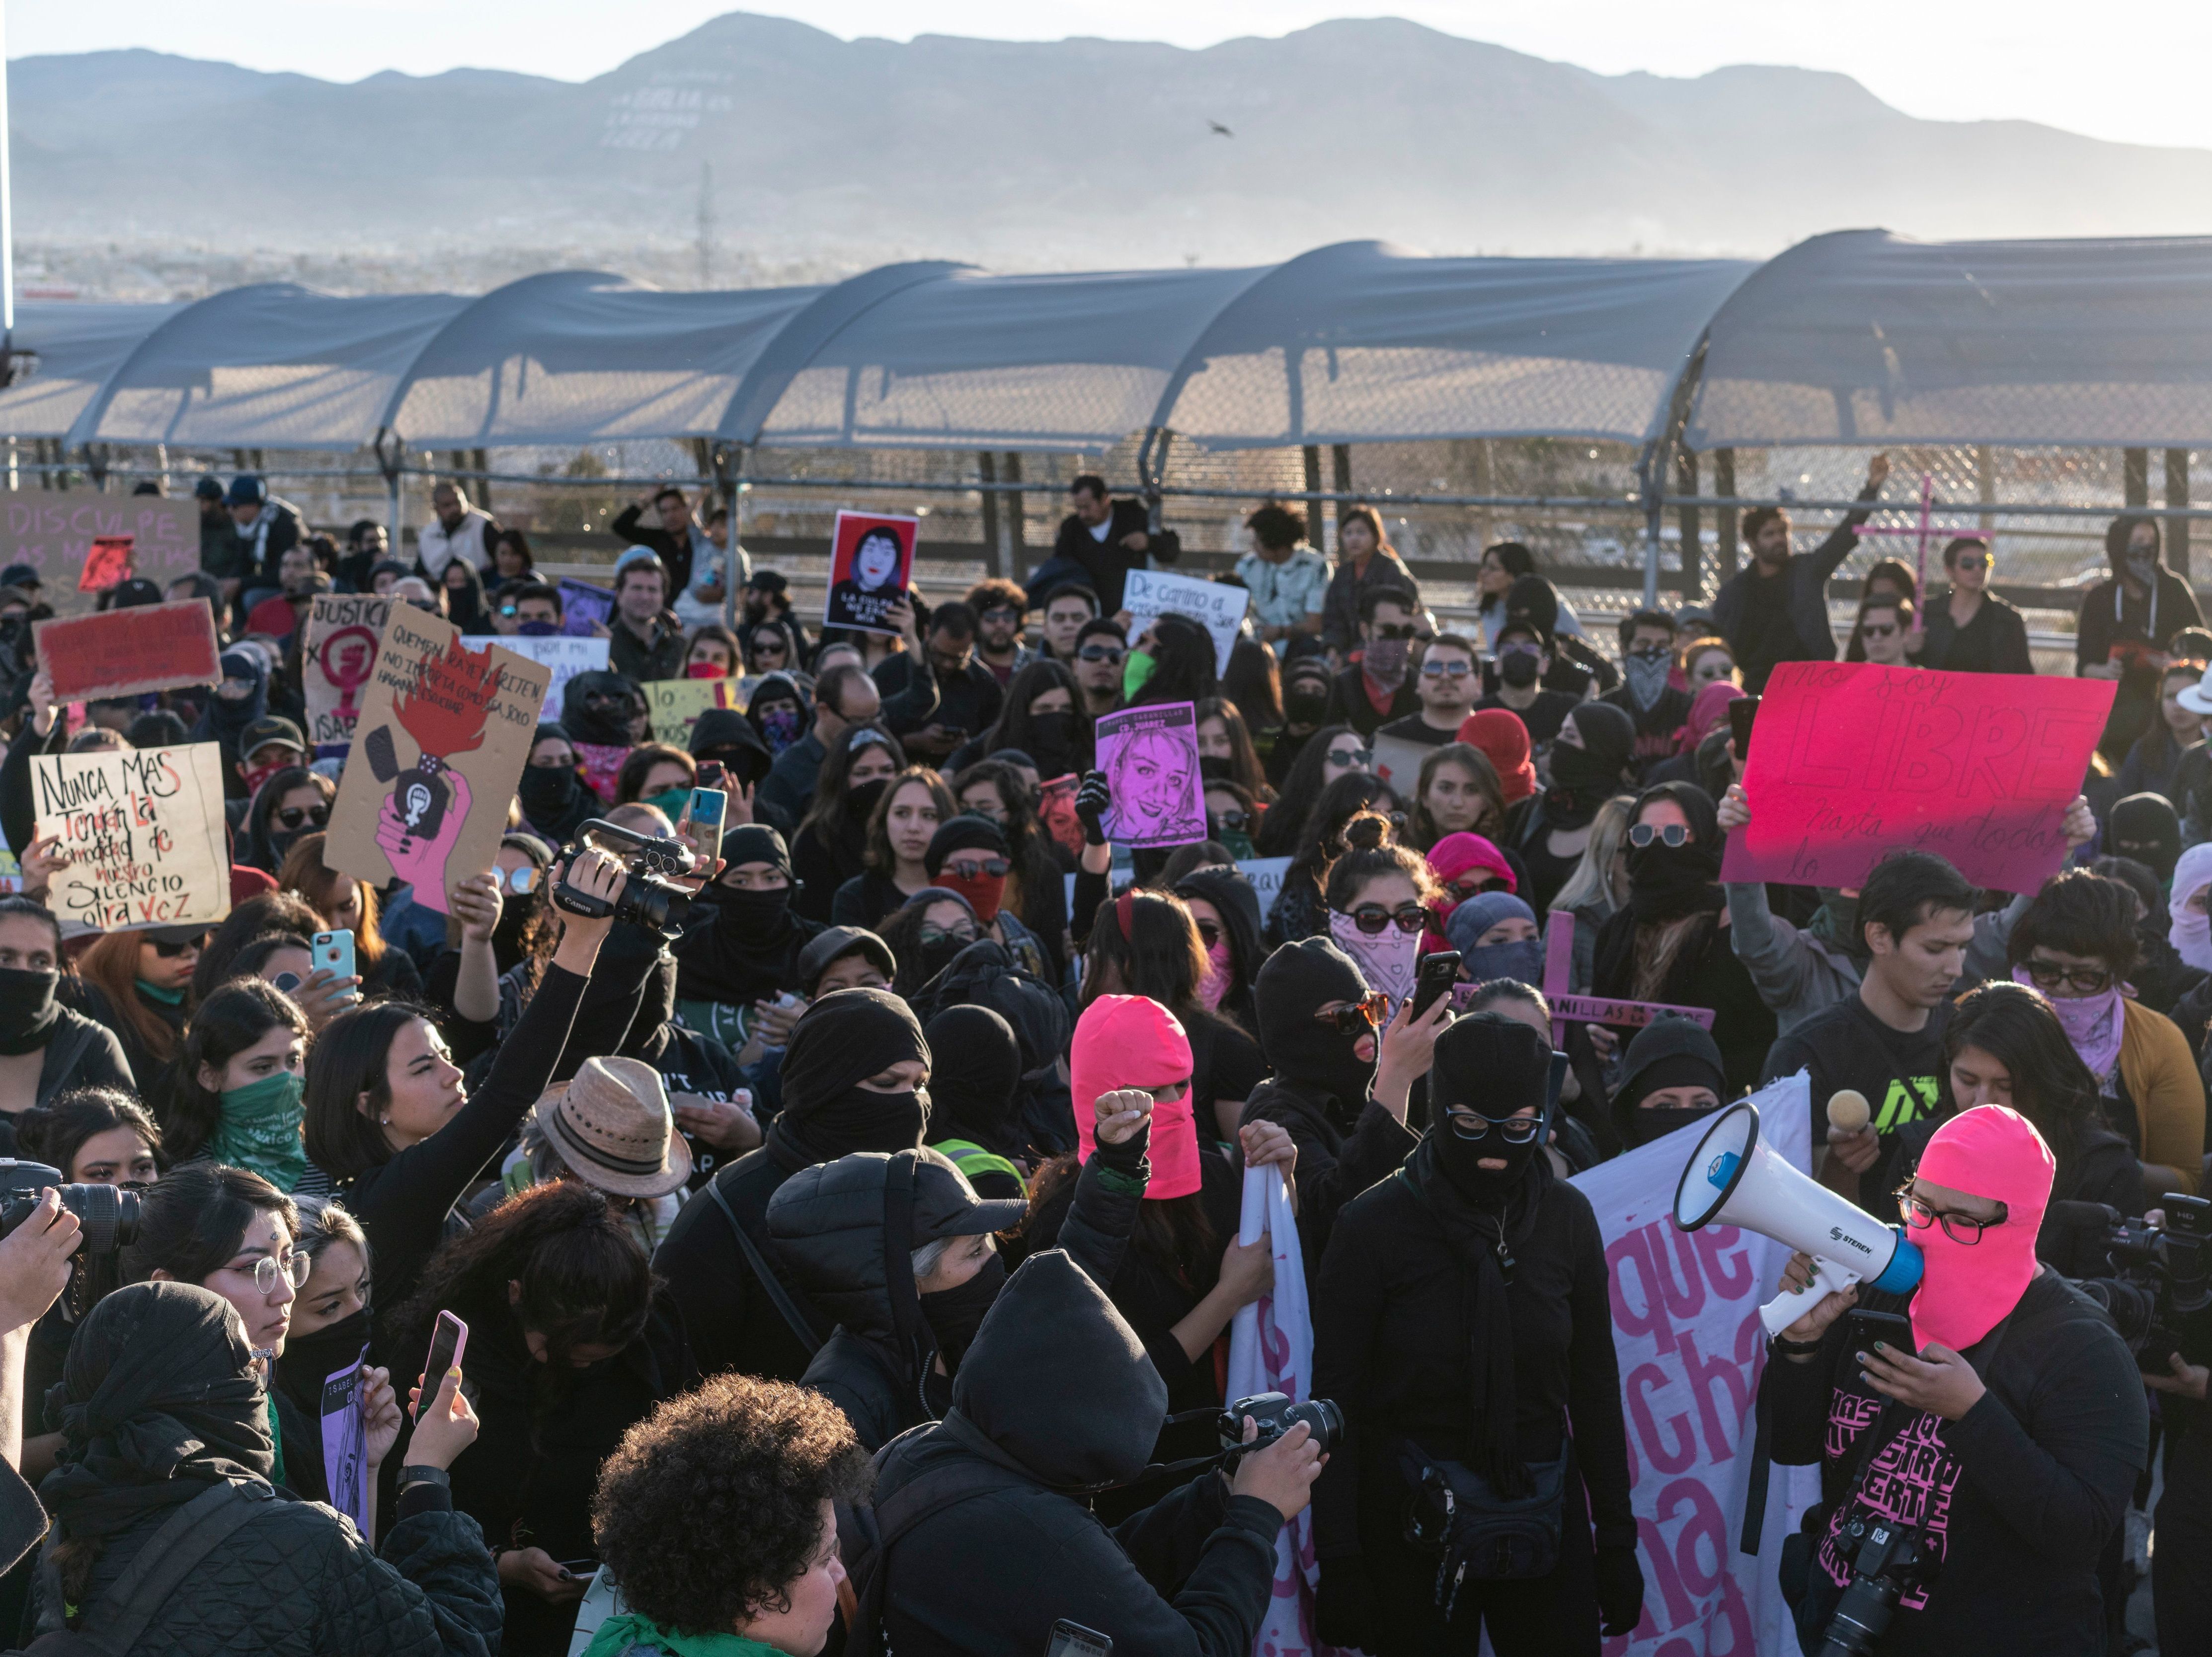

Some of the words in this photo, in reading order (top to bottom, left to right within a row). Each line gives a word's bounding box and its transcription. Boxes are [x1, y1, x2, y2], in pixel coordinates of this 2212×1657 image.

[8, 502, 185, 542] DISCULPE
[1130, 573, 1153, 599] De
[315, 599, 389, 627] JUSTICI
[383, 651, 402, 668] NO
[1870, 668, 1954, 705] soy
[316, 714, 357, 741] ISAB
[1783, 697, 2102, 801] LIBRE
[564, 897, 591, 913] Canon
[1547, 998, 1624, 1020] ANILLAS
[2177, 1211, 2194, 1220] HD
[1843, 1235, 1872, 1254] STEREN
[2112, 1236, 2132, 1245] SONY
[1605, 1211, 1754, 1356] que
[329, 1379, 353, 1395] ISABEL
[1625, 1309, 1769, 1490] cha
